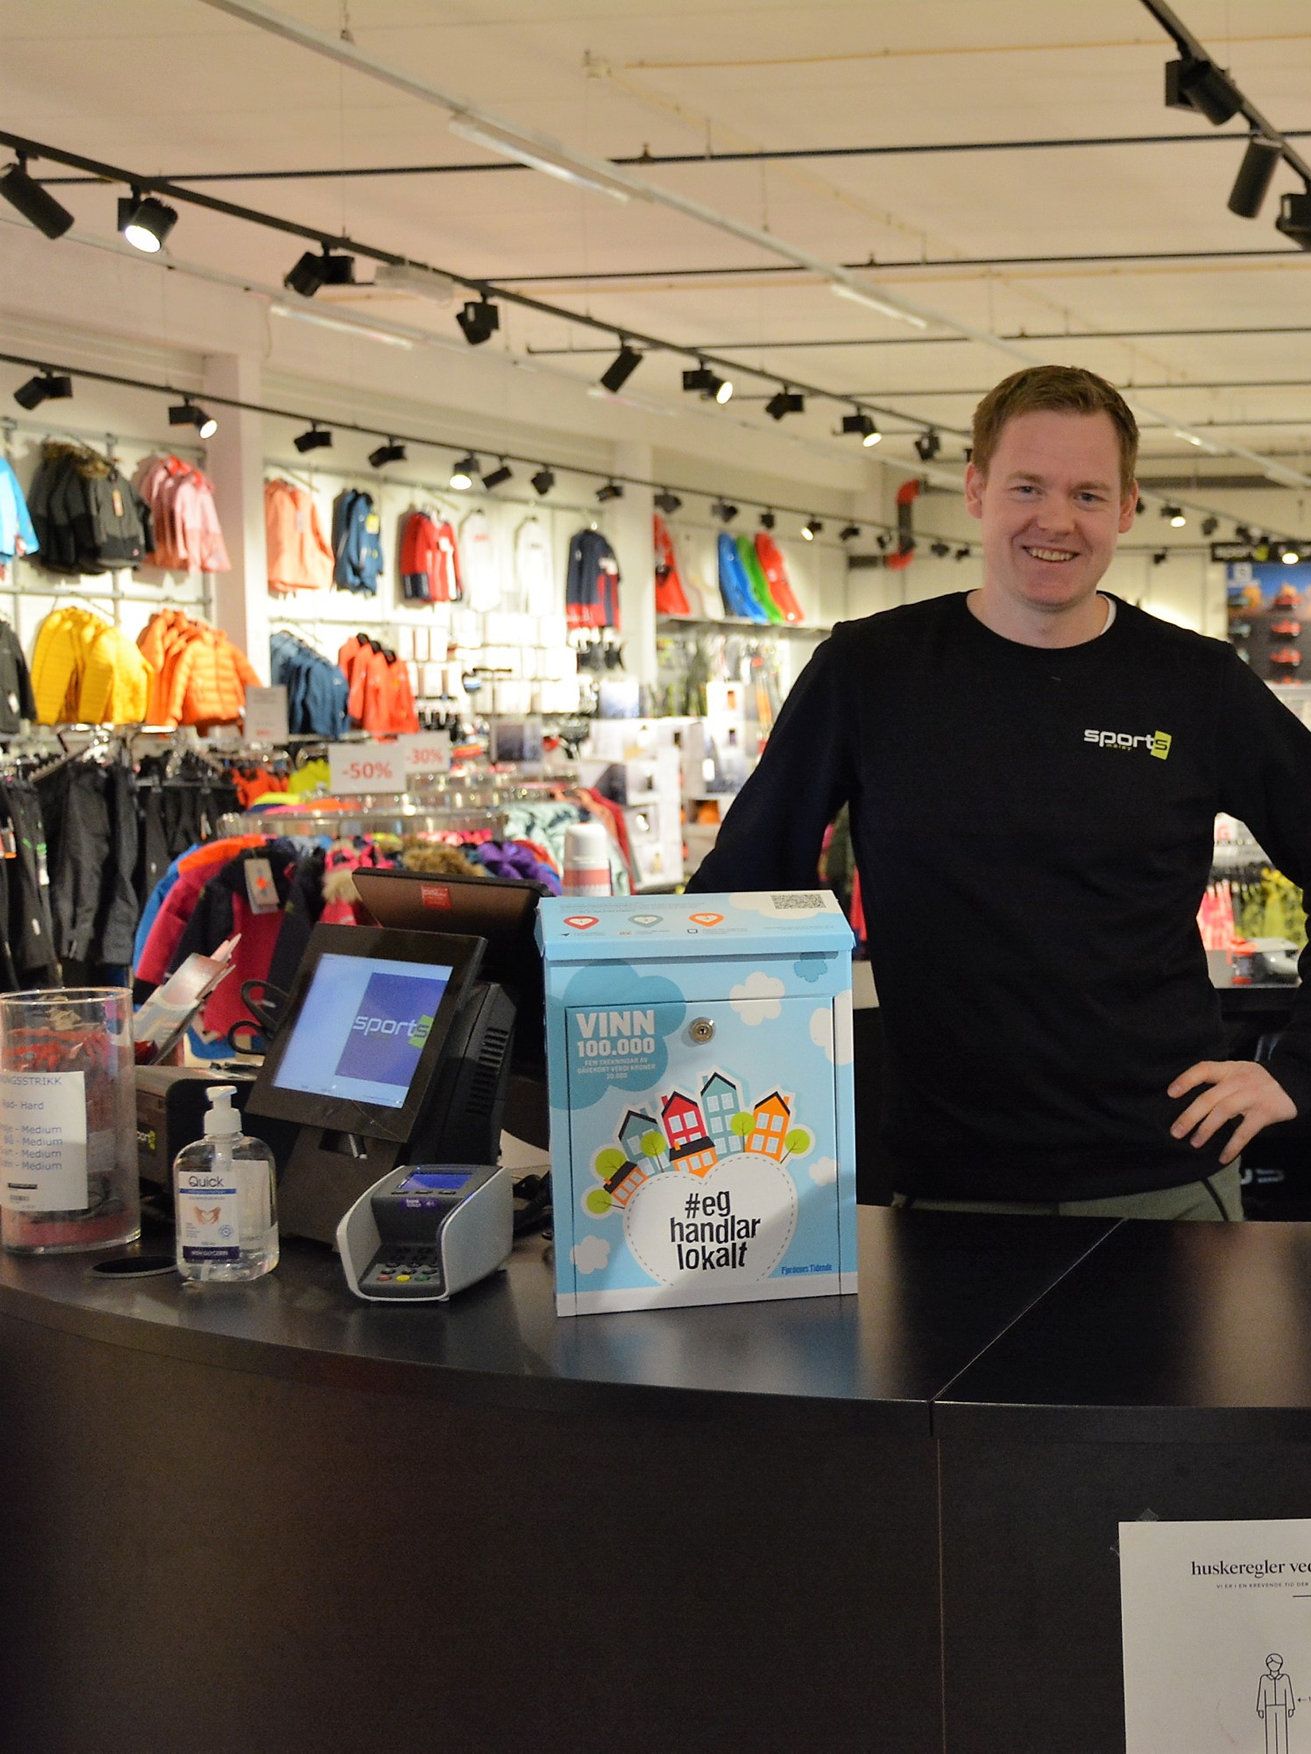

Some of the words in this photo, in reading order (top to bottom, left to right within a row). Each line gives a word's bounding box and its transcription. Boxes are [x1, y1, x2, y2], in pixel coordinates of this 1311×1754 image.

[1083, 729, 1171, 758] sports
[342, 762, 393, 780] -50%
[353, 1014, 434, 1045] sports
[576, 1010, 655, 1039] VINN
[577, 1037, 656, 1057] 100.000
[21, 1102, 44, 1110] Hard
[22, 1125, 63, 1134] Medium
[22, 1137, 63, 1147] Medium
[22, 1149, 63, 1158] Medium
[22, 1161, 63, 1171] Medium
[189, 1175, 224, 1187] Quick
[685, 1191, 731, 1219] #eg
[670, 1215, 761, 1244] handlar
[677, 1242, 748, 1270] lokalt
[1191, 1559, 1285, 1579] huskeregler
